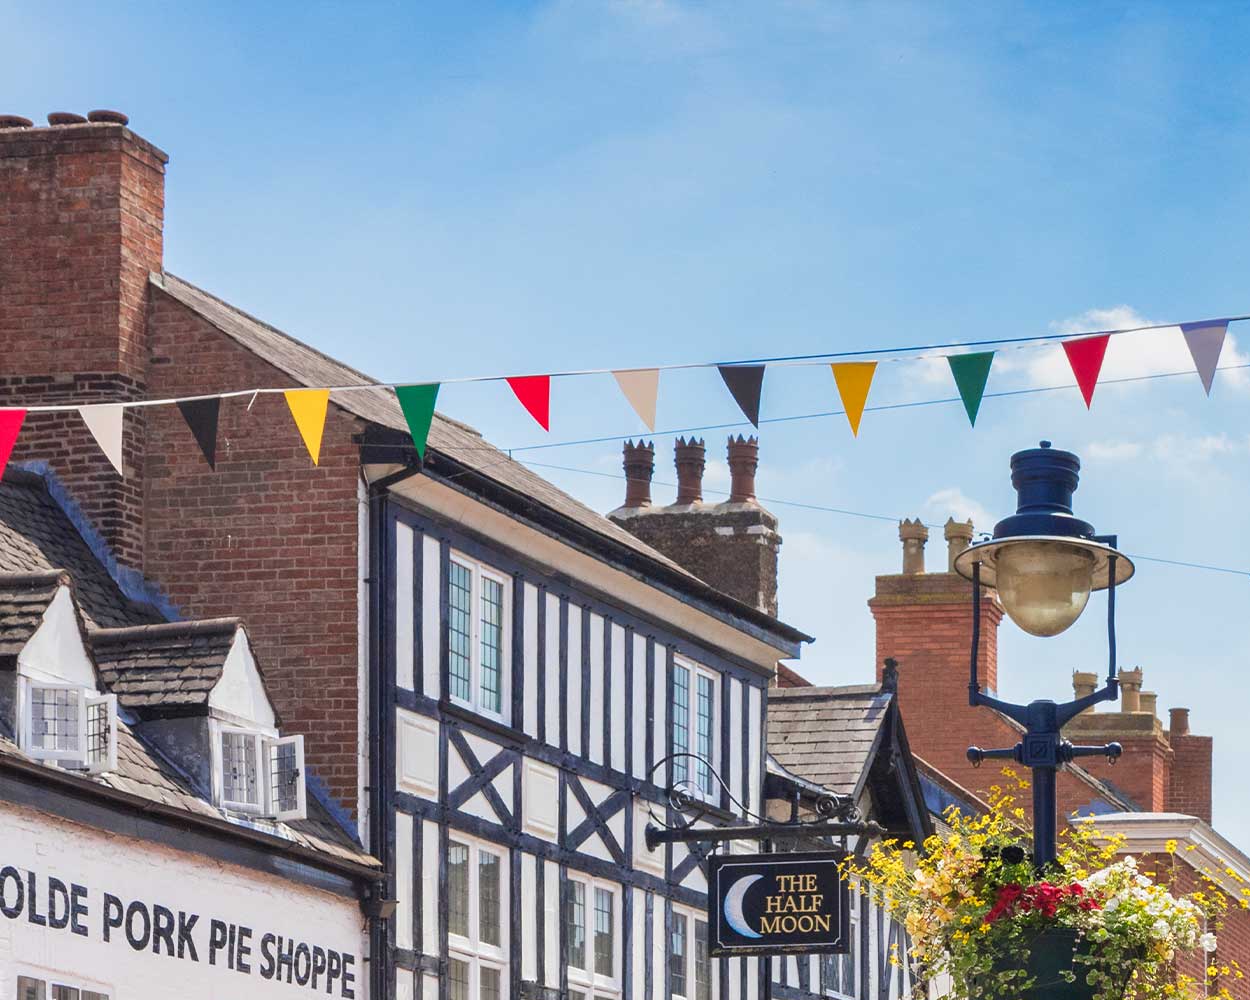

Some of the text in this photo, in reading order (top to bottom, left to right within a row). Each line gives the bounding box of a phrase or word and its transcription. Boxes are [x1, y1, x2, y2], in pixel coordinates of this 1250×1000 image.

[776, 874, 817, 892] THE
[766, 895, 823, 913] HALF
[0, 866, 355, 1000] OLDE PORK PIE SHOPPE
[760, 915, 831, 934] MOON
